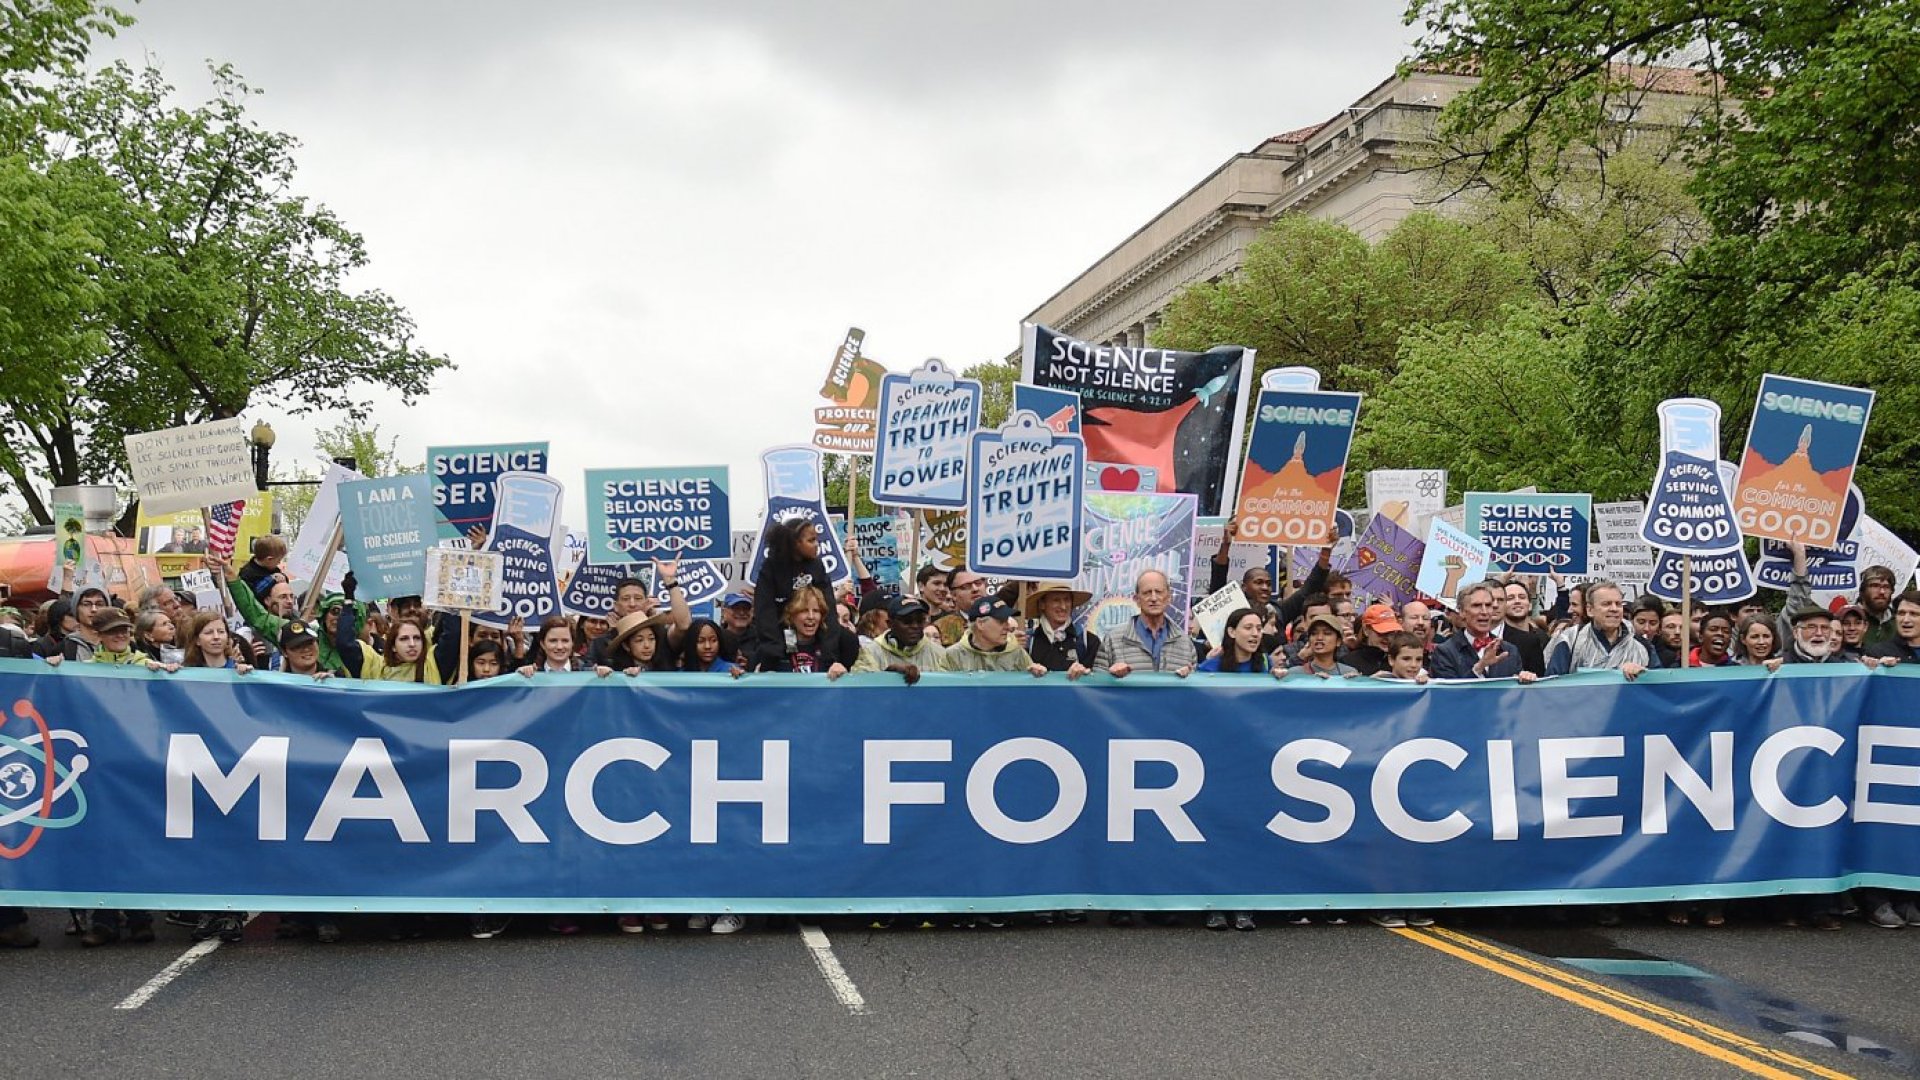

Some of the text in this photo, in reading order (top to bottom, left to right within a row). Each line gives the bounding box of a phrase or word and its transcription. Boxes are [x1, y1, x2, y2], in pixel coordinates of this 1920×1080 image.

[833, 336, 860, 387] SCIENCE
[1051, 336, 1177, 374] SCIENCE
[1050, 363, 1090, 383] NOT
[1093, 369, 1175, 393] SILENCE
[897, 384, 951, 407] SCIENCE
[1080, 388, 1094, 398] FOR
[1097, 390, 1136, 402] SCIENCE
[818, 408, 876, 420] PROTECTI
[891, 396, 971, 425] SPEAKING
[1260, 404, 1354, 427] SCIENCE
[1762, 392, 1864, 424] SCIENCE
[843, 423, 869, 433] OUR
[889, 416, 968, 448] TRUTH
[815, 434, 874, 449] COMMUNI
[433, 450, 541, 476] SCIENCE
[918, 446, 933, 461] TO
[988, 441, 1050, 468] SCIENCE
[884, 458, 964, 491] POWER
[983, 452, 1072, 489] SPEAKING
[1669, 463, 1714, 480] SCIENCE
[143, 470, 251, 496] THE NATURAL WORLD
[603, 478, 711, 497] SCIENCE
[1665, 482, 1719, 495] SERVING
[357, 485, 414, 504] I AM A
[433, 481, 499, 506] SERV
[982, 475, 1072, 514] TRUTH
[1682, 494, 1699, 503] THE
[1742, 488, 1837, 517] COMMON
[604, 498, 711, 514] BELONGS TO
[1245, 497, 1330, 517] COMMON
[1479, 503, 1573, 519] SCIENCE
[1658, 503, 1726, 519] COMMON
[359, 501, 420, 536] FORCE
[605, 515, 712, 534] EVERYONE
[934, 516, 967, 533] SAVIN
[1017, 511, 1032, 527] TO
[1239, 516, 1327, 540] GOOD
[1479, 521, 1571, 533] BELONGS TO
[1736, 506, 1832, 541] GOOD
[1085, 513, 1160, 554] CIENCE
[1653, 518, 1730, 541] GOOD
[364, 535, 382, 550] FOR
[383, 530, 420, 547] SCIENCE
[497, 539, 545, 556] SCIENCE
[982, 525, 1070, 562] POWER
[1435, 532, 1484, 566] SOLUTION
[1480, 536, 1572, 550] EVERYONE
[862, 546, 895, 557] ITICS
[503, 556, 548, 573] RVING
[506, 568, 525, 579] THE
[582, 566, 624, 579] SERVING
[658, 566, 709, 588] CMMON
[1762, 568, 1853, 586] COMNITIES
[502, 581, 551, 595] MMON
[575, 580, 616, 595] COMM
[495, 596, 554, 618] OOD
[570, 590, 616, 610] GOO
[165, 724, 1920, 845] MARCH FOR SCIENCE
